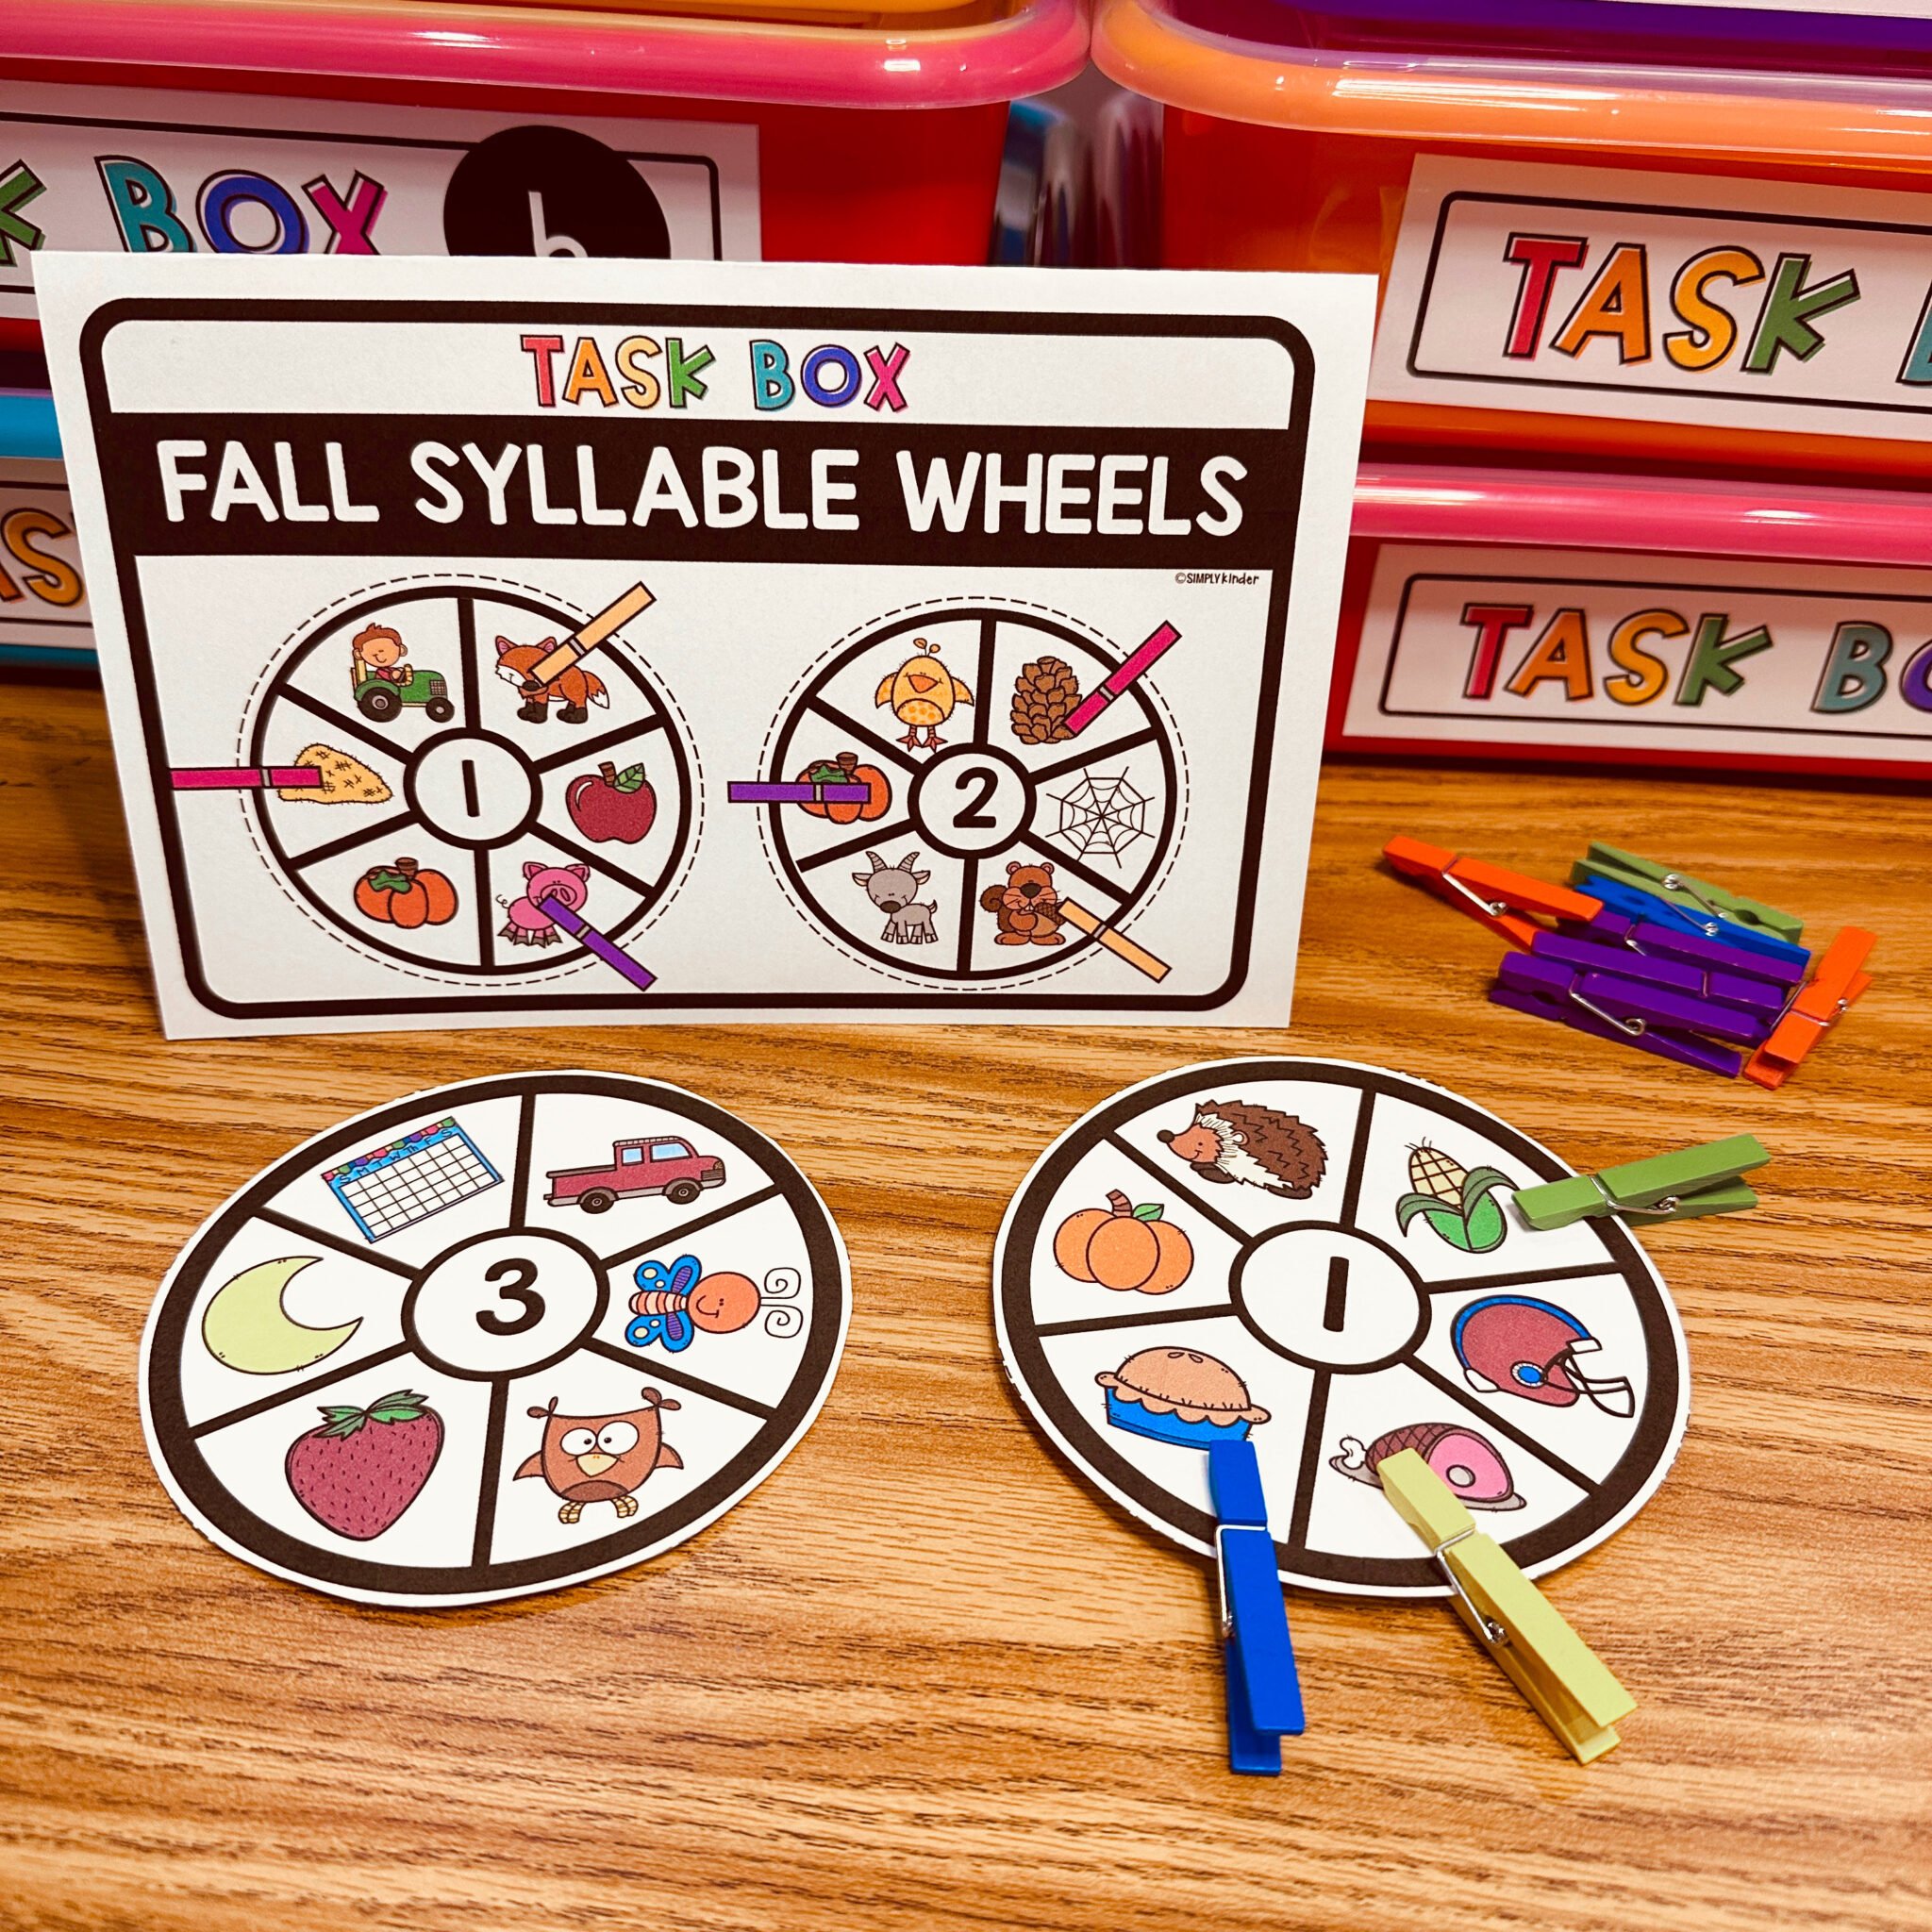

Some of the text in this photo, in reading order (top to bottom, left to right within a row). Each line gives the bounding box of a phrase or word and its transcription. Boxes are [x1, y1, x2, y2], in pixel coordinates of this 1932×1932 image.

[93, 155, 388, 255] BOX
[1502, 231, 1861, 375] TASK
[520, 334, 911, 413] TASK BOX
[157, 440, 1248, 537] FALL SYLLABLE WHEELS
[1460, 601, 1774, 707] TASK
[952, 767, 999, 829] 2
[475, 1257, 547, 1337] 3
[1323, 1256, 1350, 1332] 1
